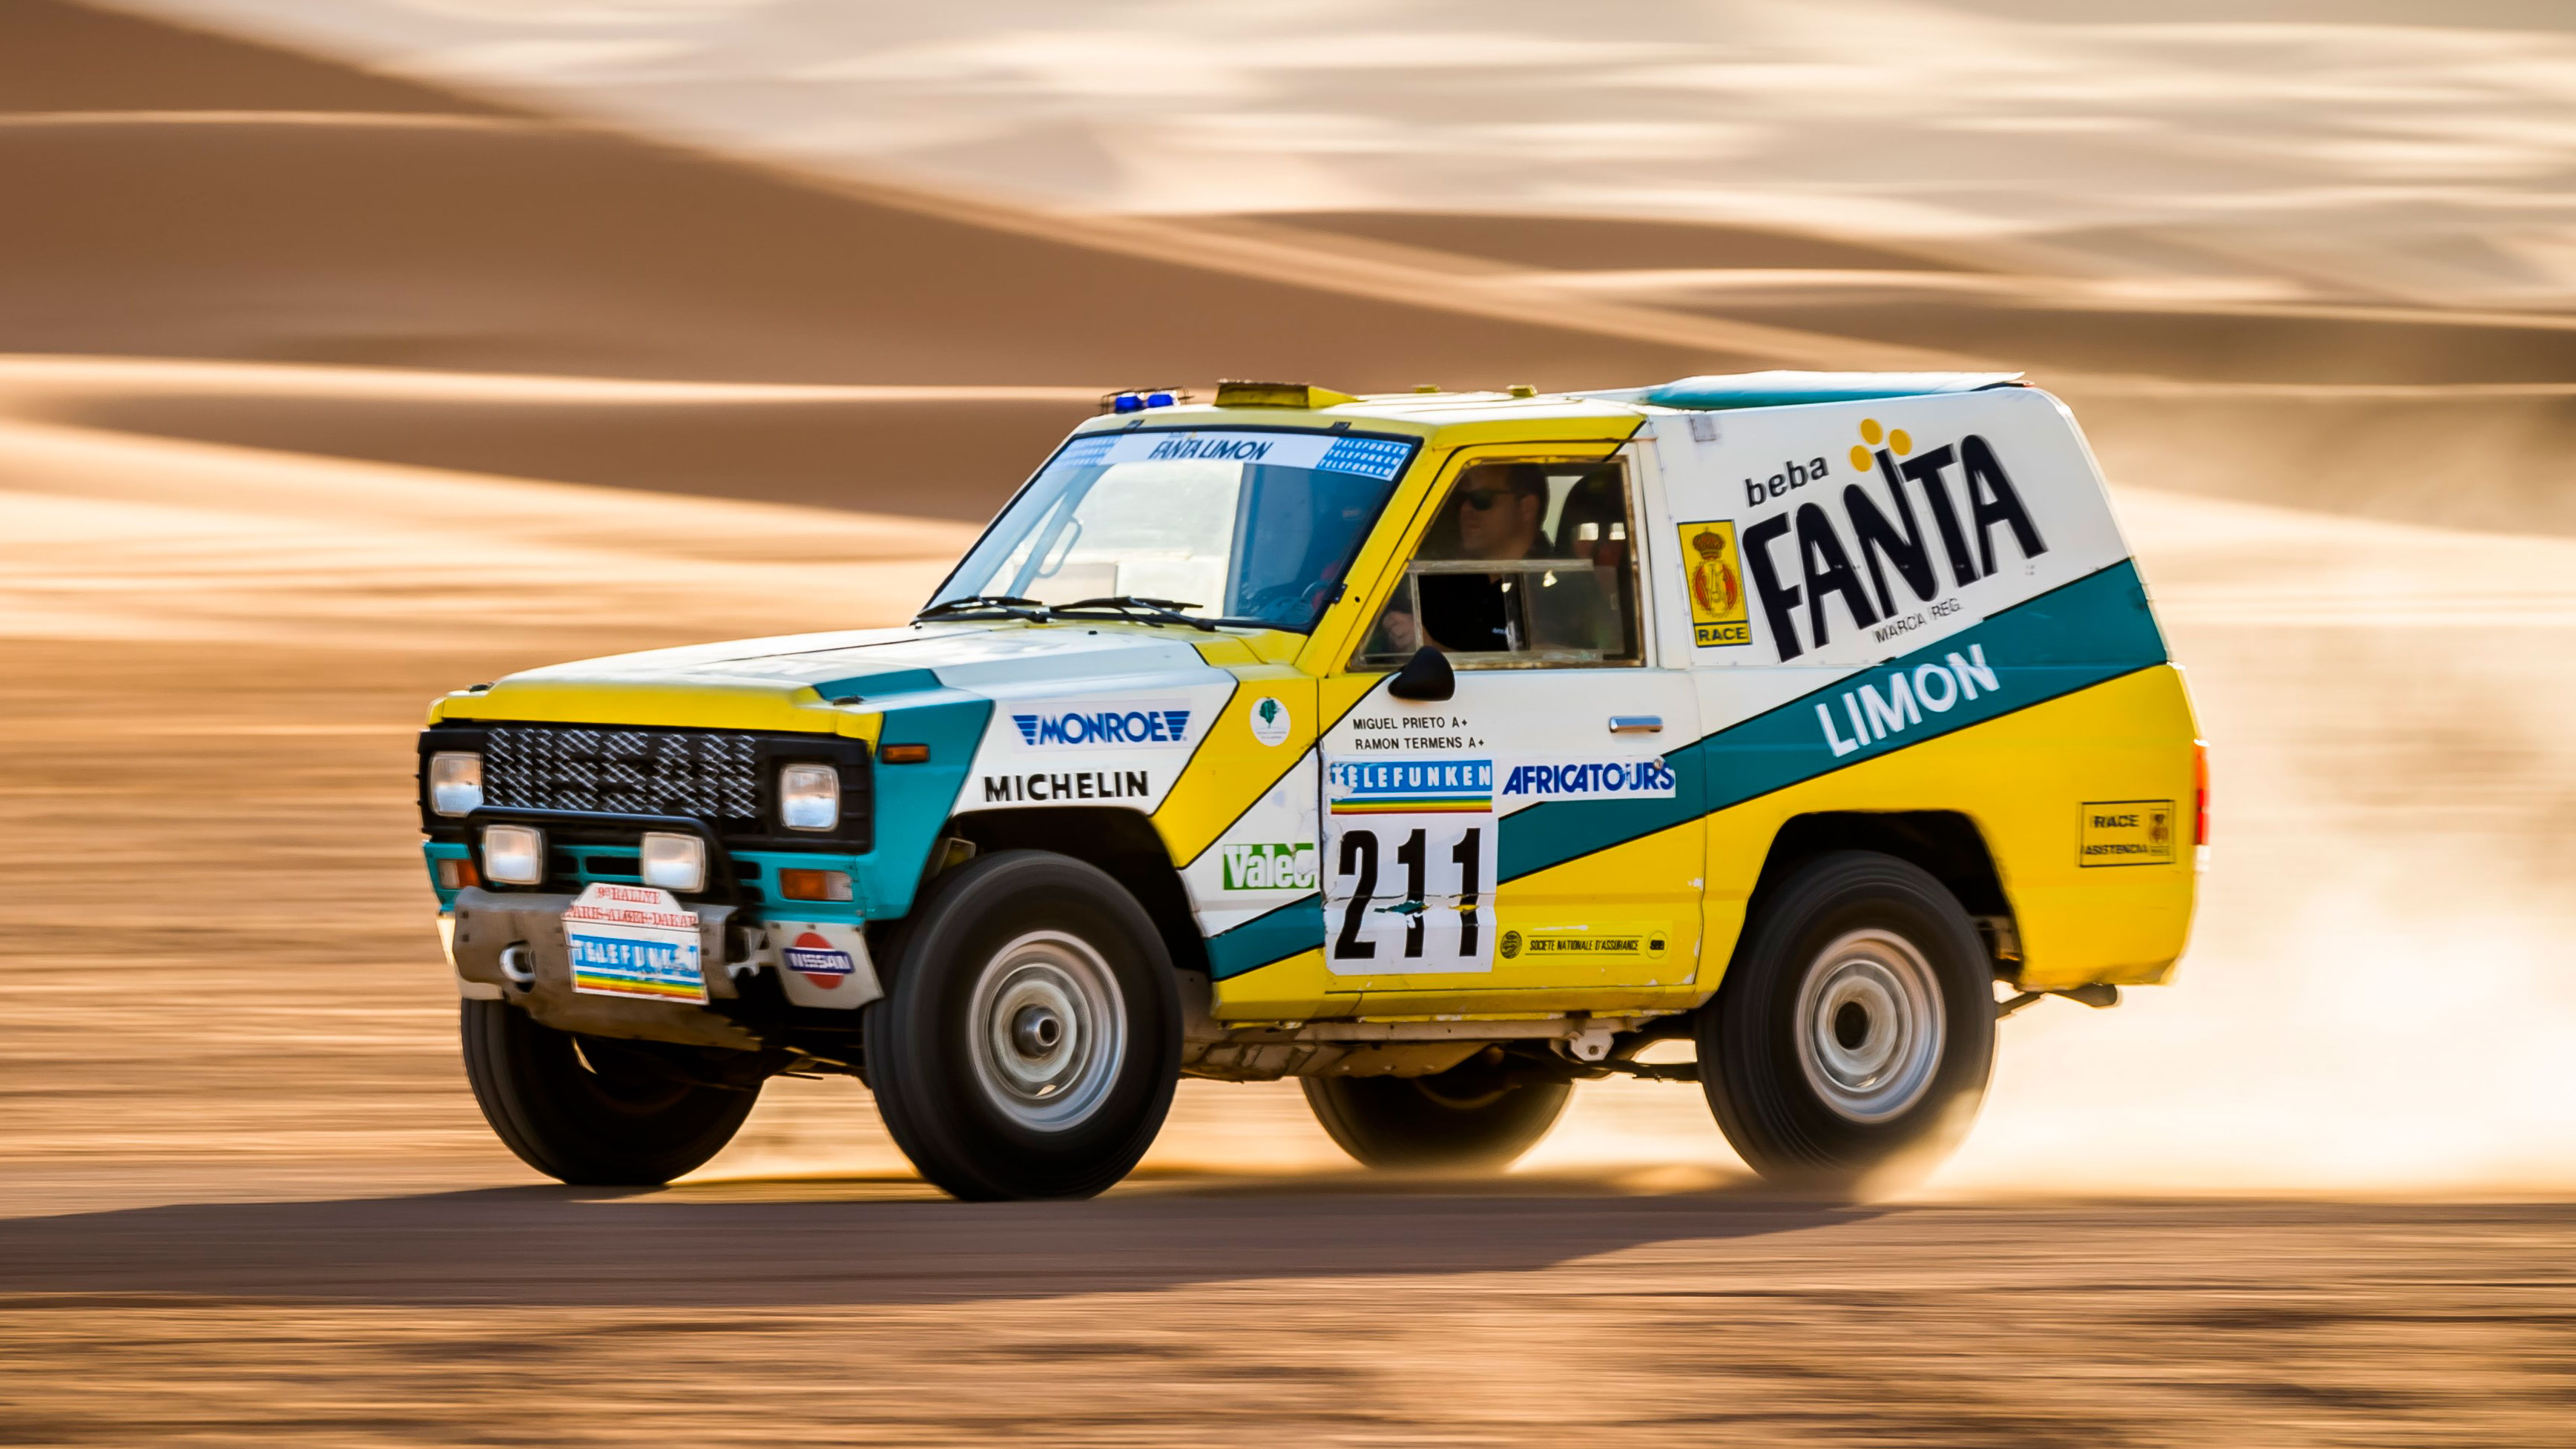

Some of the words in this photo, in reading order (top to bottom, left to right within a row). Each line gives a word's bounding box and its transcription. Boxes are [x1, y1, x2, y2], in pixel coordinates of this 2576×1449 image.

[1148, 439, 1203, 459] FANTA
[1199, 439, 1274, 461] LIMON
[1745, 456, 1829, 507] beba
[1742, 434, 2049, 663] FANTA
[1698, 627, 1748, 641] RACE
[1873, 613, 1926, 643] MARCA
[1815, 643, 2000, 757] LIMON
[1039, 711, 1168, 745] MONROE
[1353, 718, 1397, 729] MIGUEL
[1403, 717, 1445, 728] PRIETO
[1355, 739, 1399, 750] RAMON
[1404, 737, 1463, 749] TERMENS
[984, 770, 1149, 802] MICHELIN
[1332, 765, 1491, 788] TELEFUNKEN
[1502, 763, 1675, 795] AFRICATOURS
[2093, 815, 2139, 828] RACE
[1334, 828, 1480, 960] 211
[1558, 940, 1592, 951] NATIONALE
[789, 953, 851, 969] NISSAN
